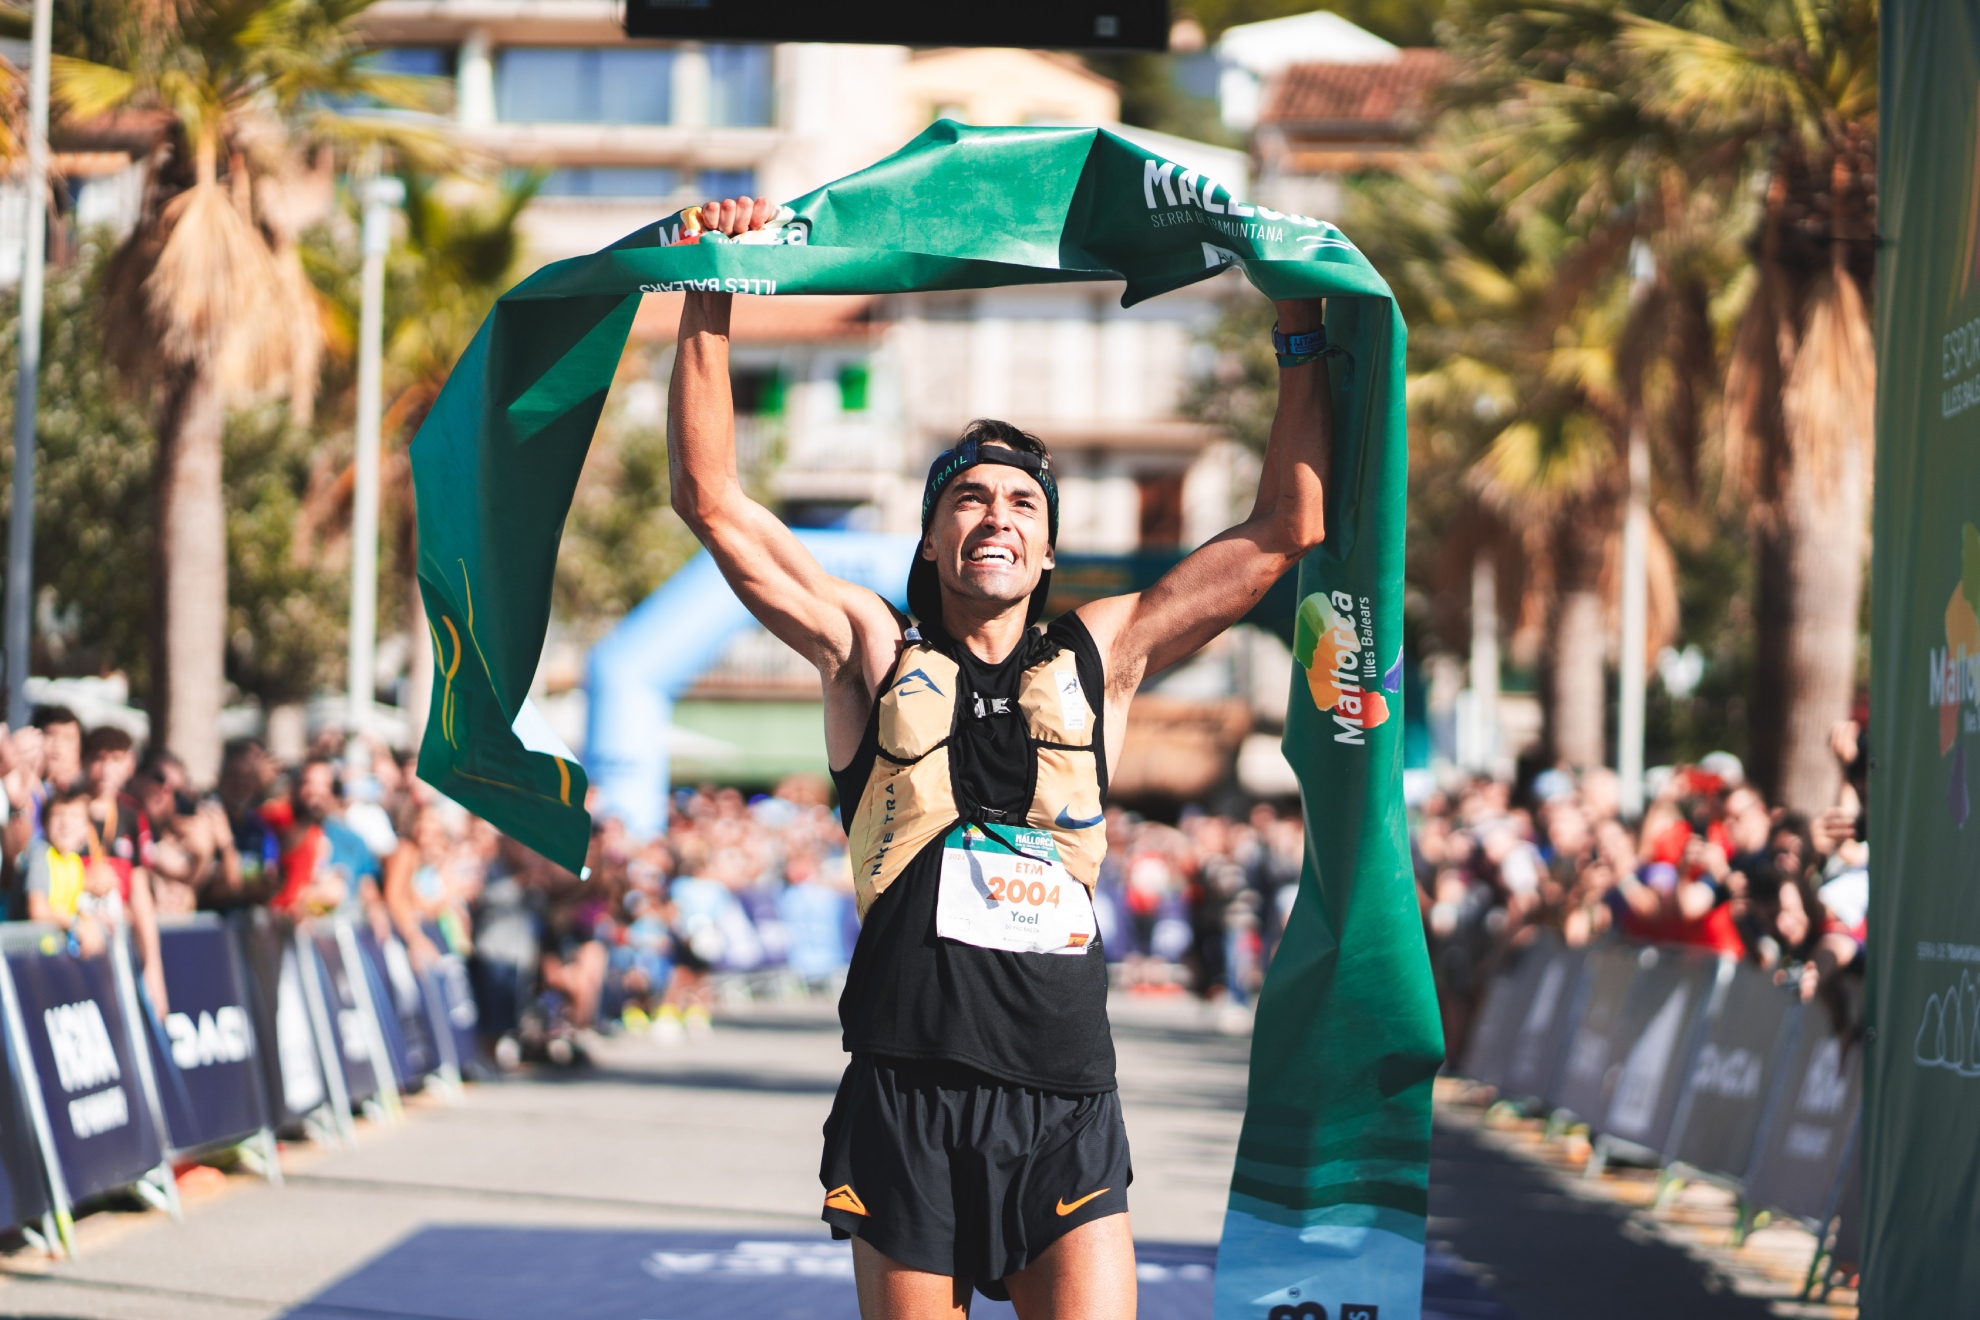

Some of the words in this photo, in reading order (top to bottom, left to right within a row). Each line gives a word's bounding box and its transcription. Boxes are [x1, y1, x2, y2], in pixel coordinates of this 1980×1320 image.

[1151, 211, 1193, 228] SERRA
[1206, 215, 1283, 243] TRAMUNTANA
[726, 278, 776, 295] ILLES
[931, 455, 967, 491] TRAIL
[1359, 597, 1374, 647] Balears
[1329, 590, 1365, 745] Mallorca
[1363, 651, 1377, 678] Illes
[871, 832, 894, 876] NIKE
[883, 768, 900, 825] TRAL
[1015, 834, 1054, 848] MALLORCA
[1015, 862, 1043, 876] ETM
[987, 876, 1061, 909] 2004
[1010, 911, 1039, 925] Yoel
